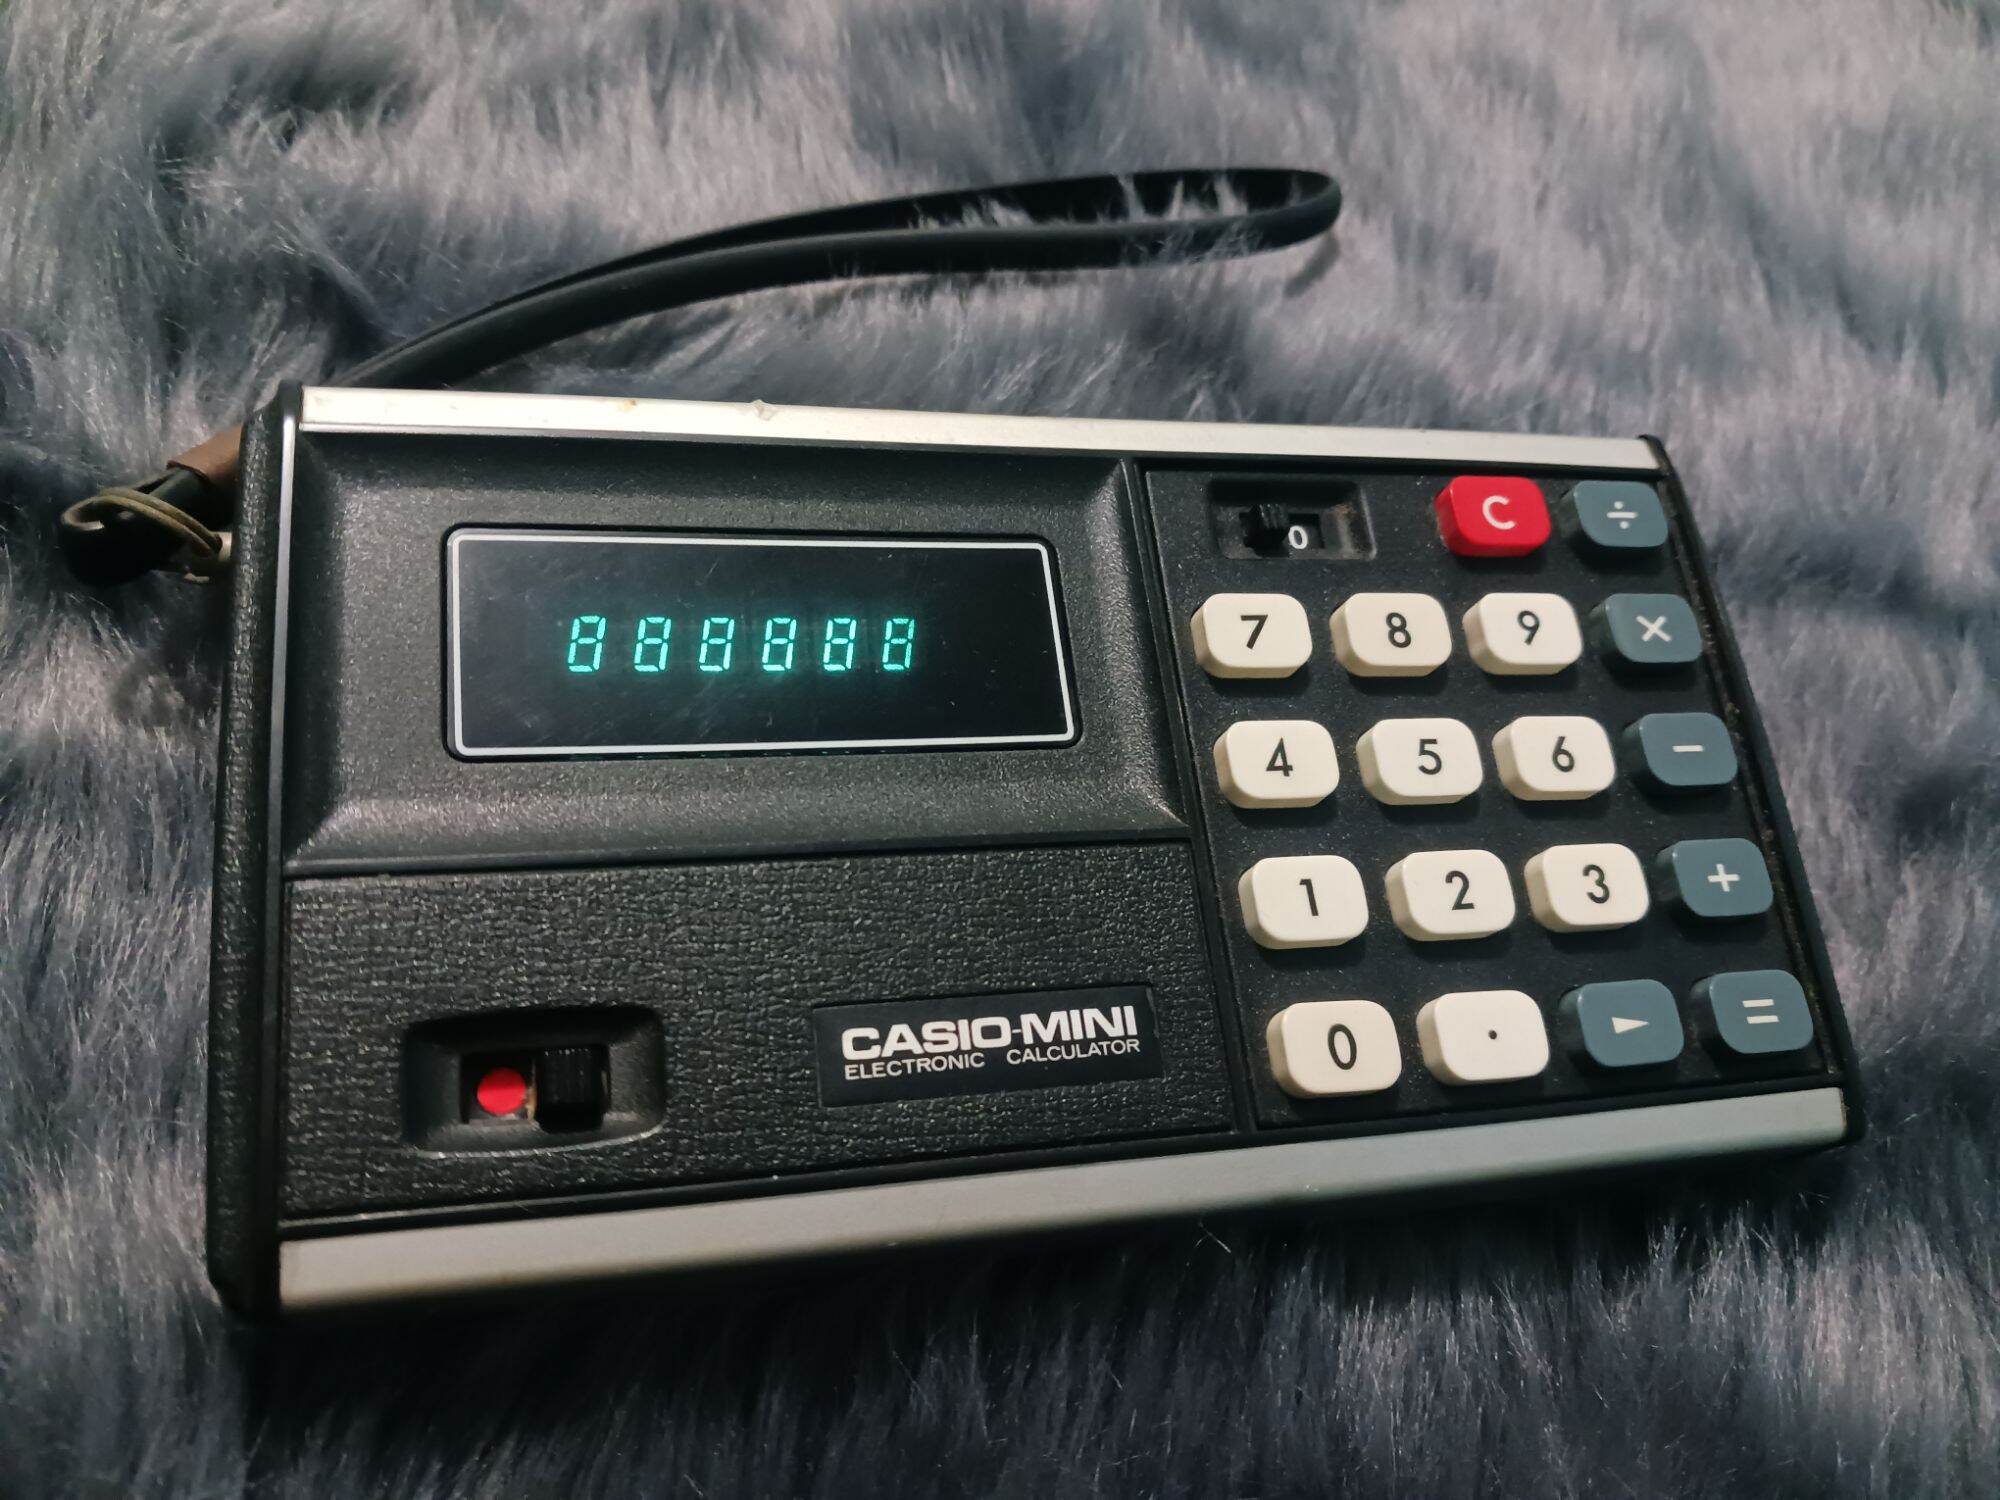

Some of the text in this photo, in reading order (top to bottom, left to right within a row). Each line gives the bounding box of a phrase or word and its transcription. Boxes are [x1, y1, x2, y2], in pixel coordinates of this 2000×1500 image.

[1482, 495, 1516, 530] C
[1240, 614, 1269, 650] 7
[1385, 612, 1412, 649] 8
[1517, 610, 1540, 645] 9
[1265, 737, 1294, 777] 4
[1418, 738, 1442, 776] 5
[1552, 735, 1575, 773] 6
[1299, 878, 1319, 917] 1
[1445, 870, 1475, 911] 2
[1582, 864, 1610, 904] 3
[841, 1004, 1139, 1061] CASIO-MINI
[1327, 1023, 1358, 1071] 0
[844, 1038, 1141, 1081] ELECTRONIC CALCULATOR
